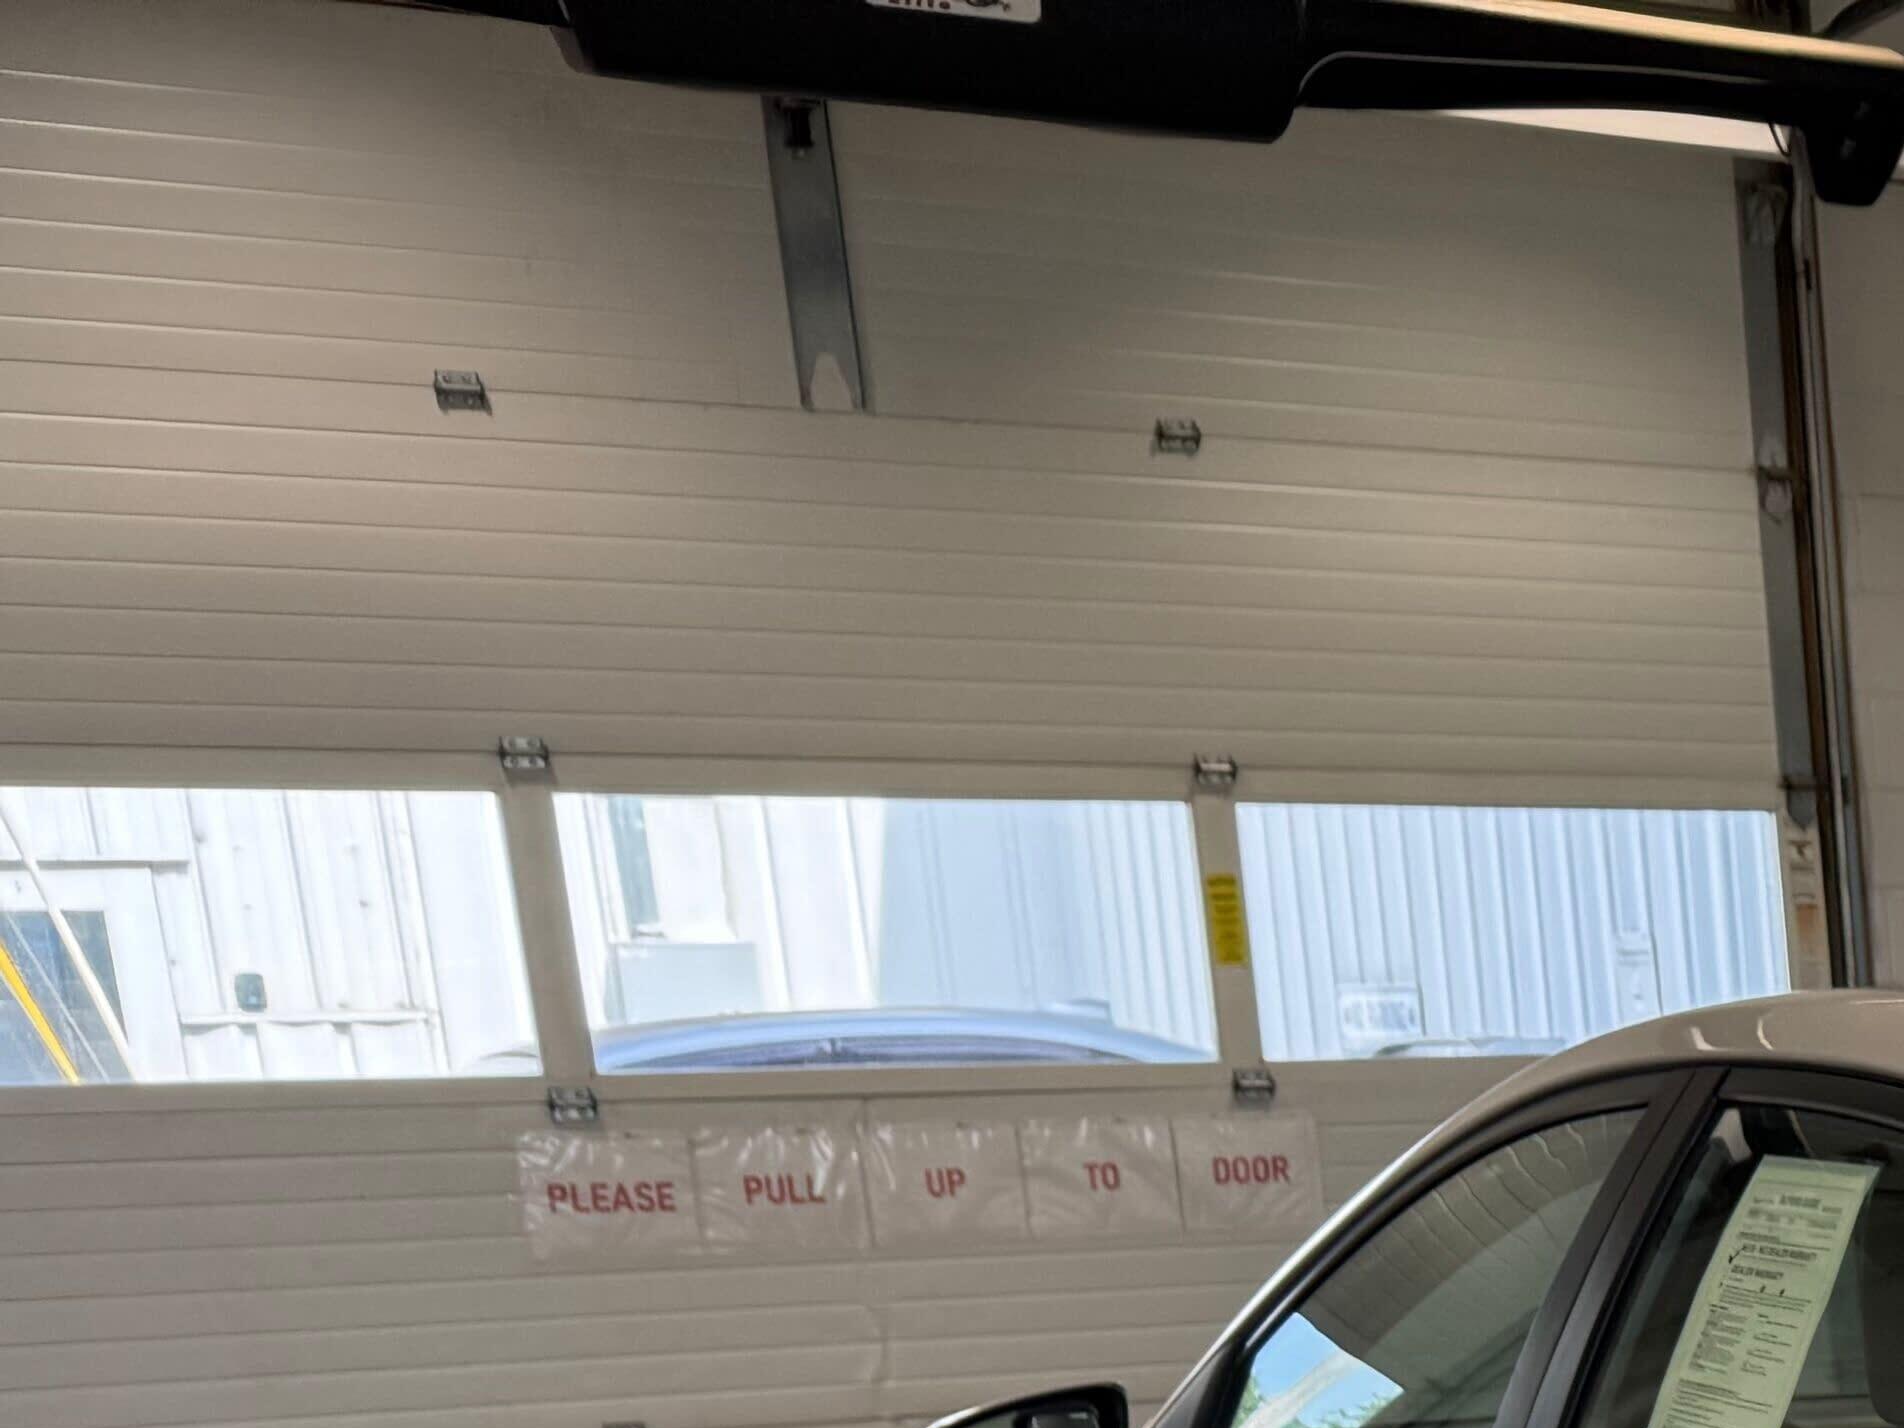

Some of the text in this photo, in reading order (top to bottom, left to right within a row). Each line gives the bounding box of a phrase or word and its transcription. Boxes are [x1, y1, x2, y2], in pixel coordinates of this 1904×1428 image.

[546, 1154, 1291, 1214] PLEASE PULL UP TO DOOR
